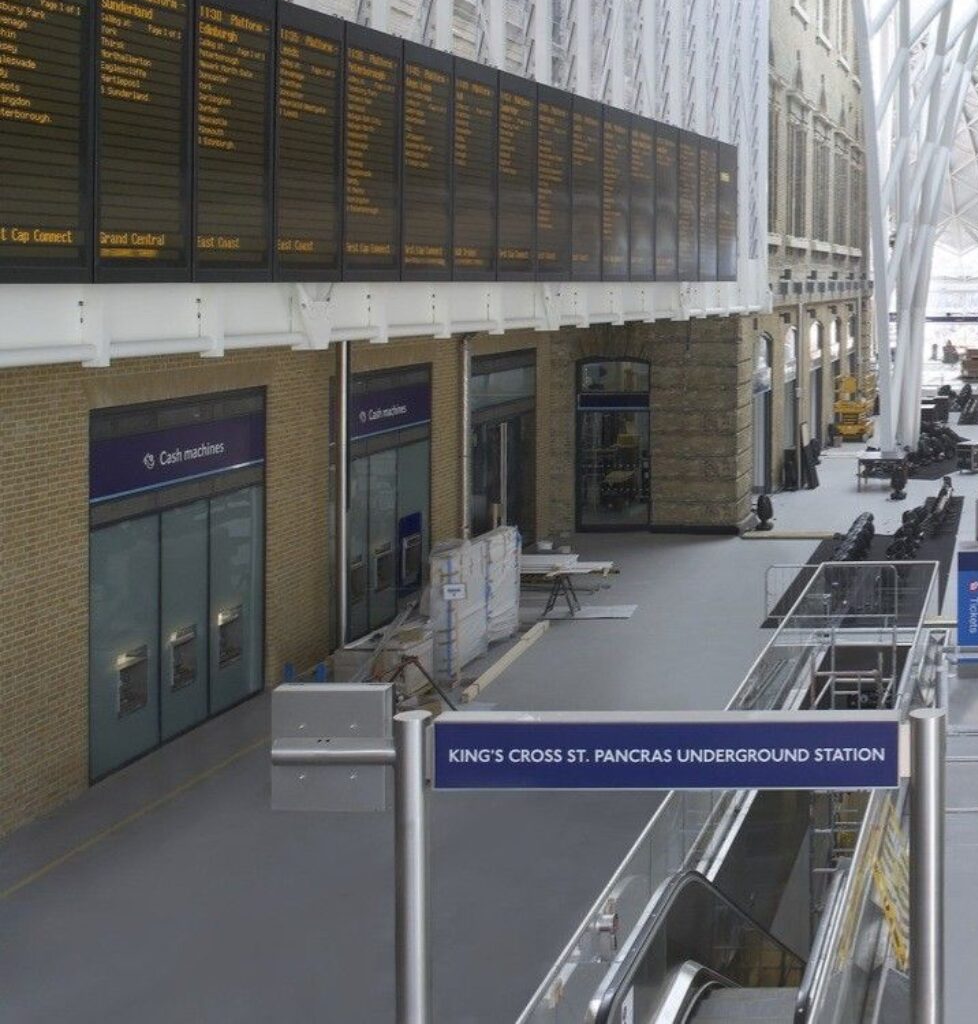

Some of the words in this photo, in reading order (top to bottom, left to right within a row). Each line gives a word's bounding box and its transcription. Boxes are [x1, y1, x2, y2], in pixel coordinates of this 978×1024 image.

[231, 14, 264, 32] Platform
[11, 228, 30, 244] Cap
[33, 229, 73, 244] Connect
[100, 231, 128, 245] Grand
[131, 232, 165, 247] Central
[217, 236, 240, 249] Coast
[369, 408, 381, 421] Cash
[383, 404, 408, 417] machines
[159, 450, 181, 467] Cash
[184, 442, 224, 460] machines
[448, 749, 503, 763] KING'S
[508, 749, 563, 763] CROSS
[567, 749, 590, 763] ST.
[595, 749, 672, 763] PANCRAS
[677, 748, 809, 763] UNDERGROUND
[815, 747, 886, 762] STATION
